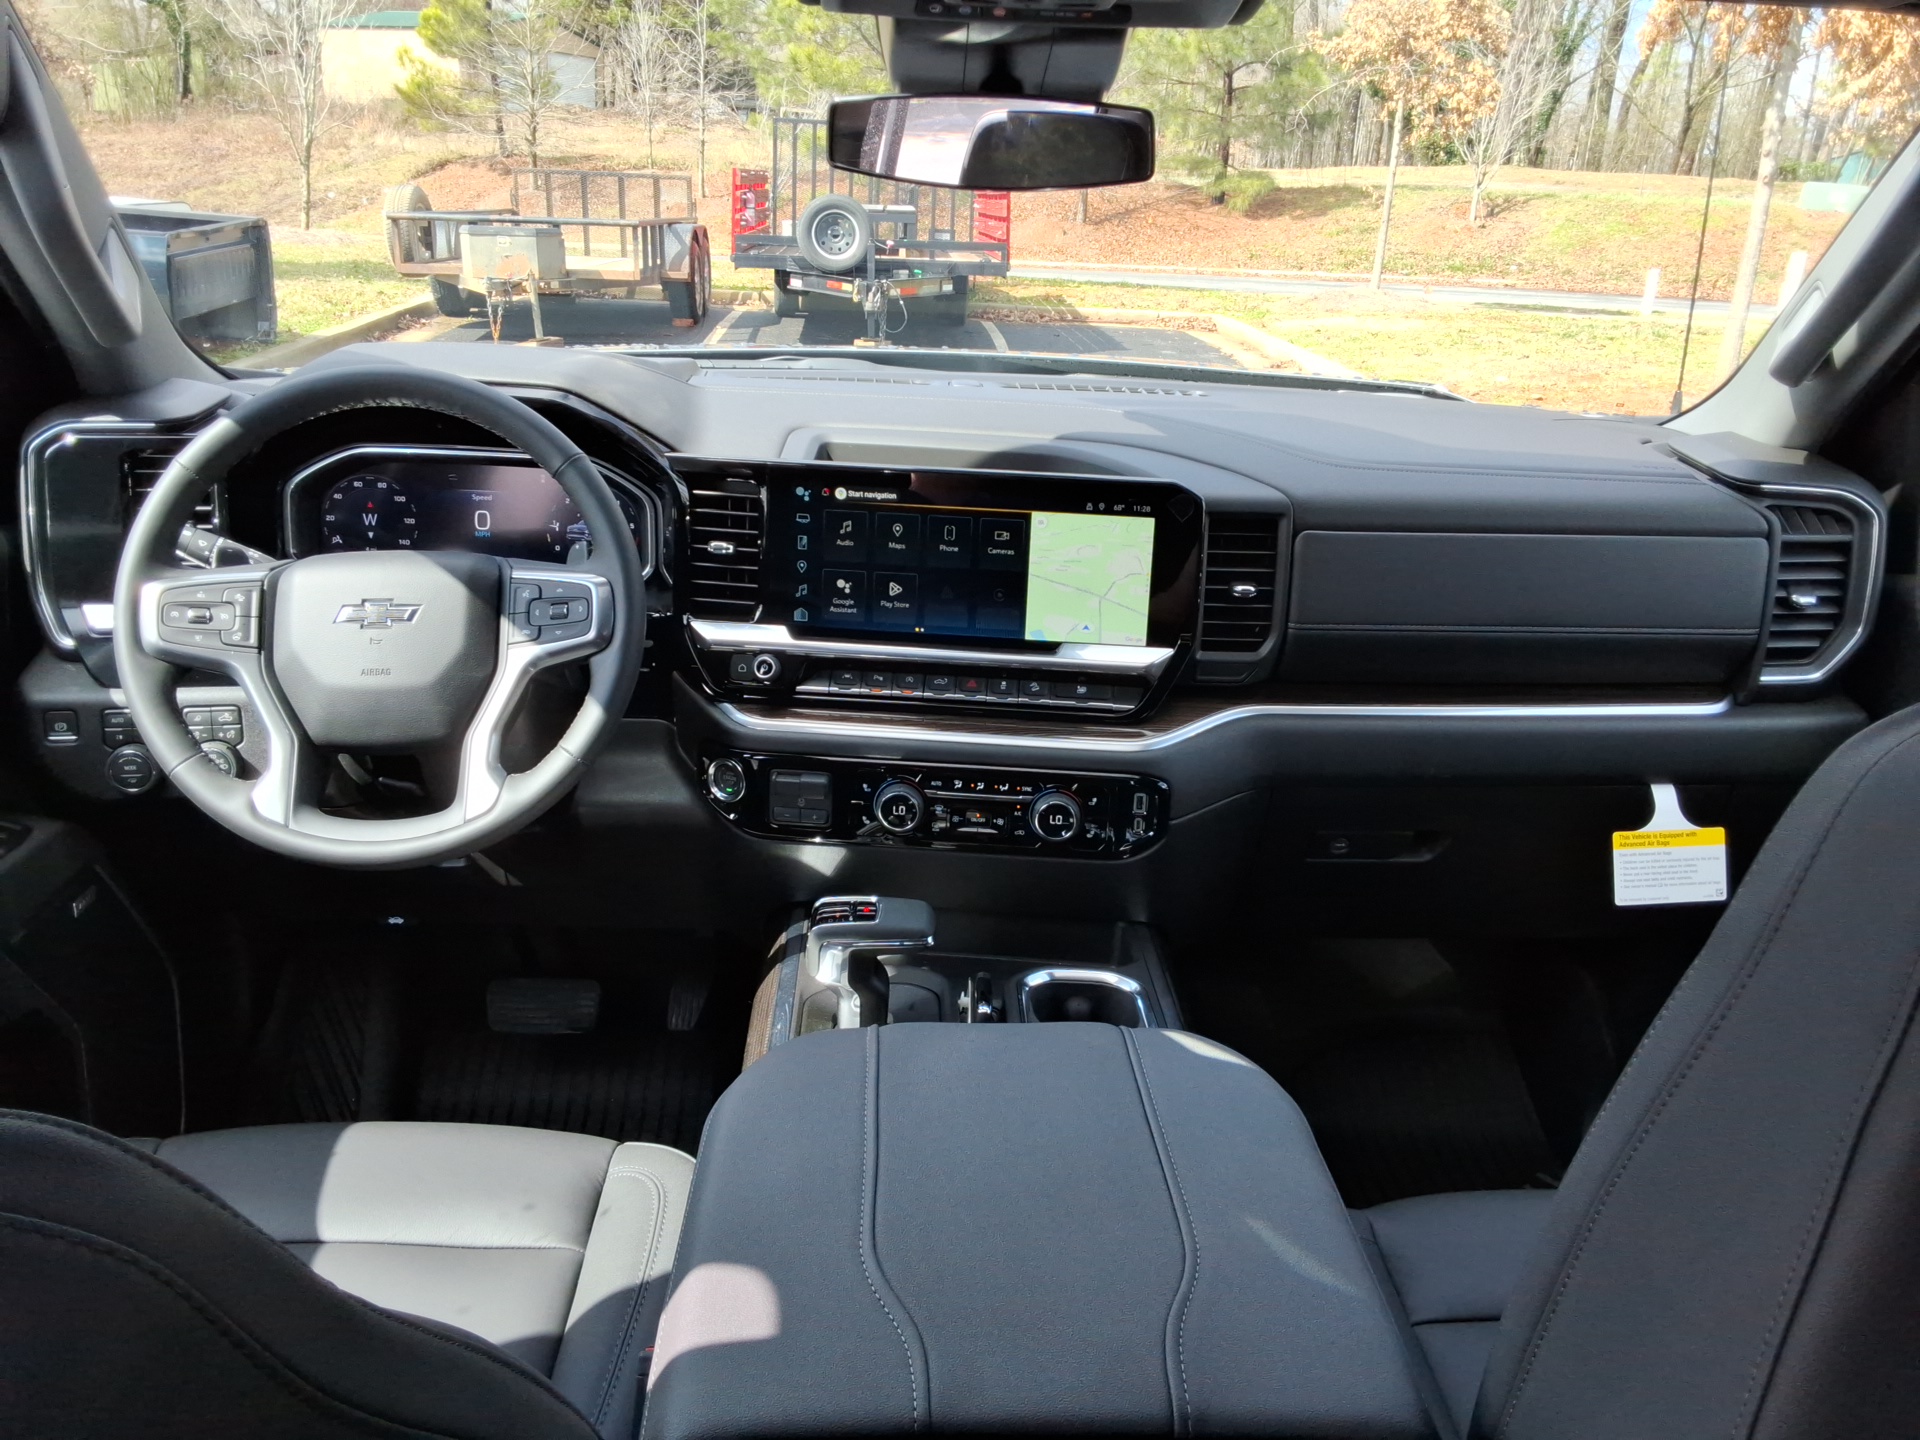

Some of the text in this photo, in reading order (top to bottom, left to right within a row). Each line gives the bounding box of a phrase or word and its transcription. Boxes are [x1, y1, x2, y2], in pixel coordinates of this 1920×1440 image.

[471, 493, 493, 502] Speed
[848, 490, 897, 500] Start navigation
[362, 513, 378, 526] W
[474, 510, 491, 530] 0
[474, 530, 491, 538] MPH
[888, 542, 906, 550] Maps
[939, 544, 959, 552] Phone
[987, 547, 1015, 555] Cameras
[832, 597, 855, 606] Google
[880, 600, 893, 608] Play
[360, 668, 392, 677] AIRBAG
[111, 716, 125, 724] AUTO
[892, 805, 906, 816] LO
[1049, 814, 1063, 825] LO
[1659, 831, 1684, 839] Equipped
[1619, 840, 1647, 848] Advanced
